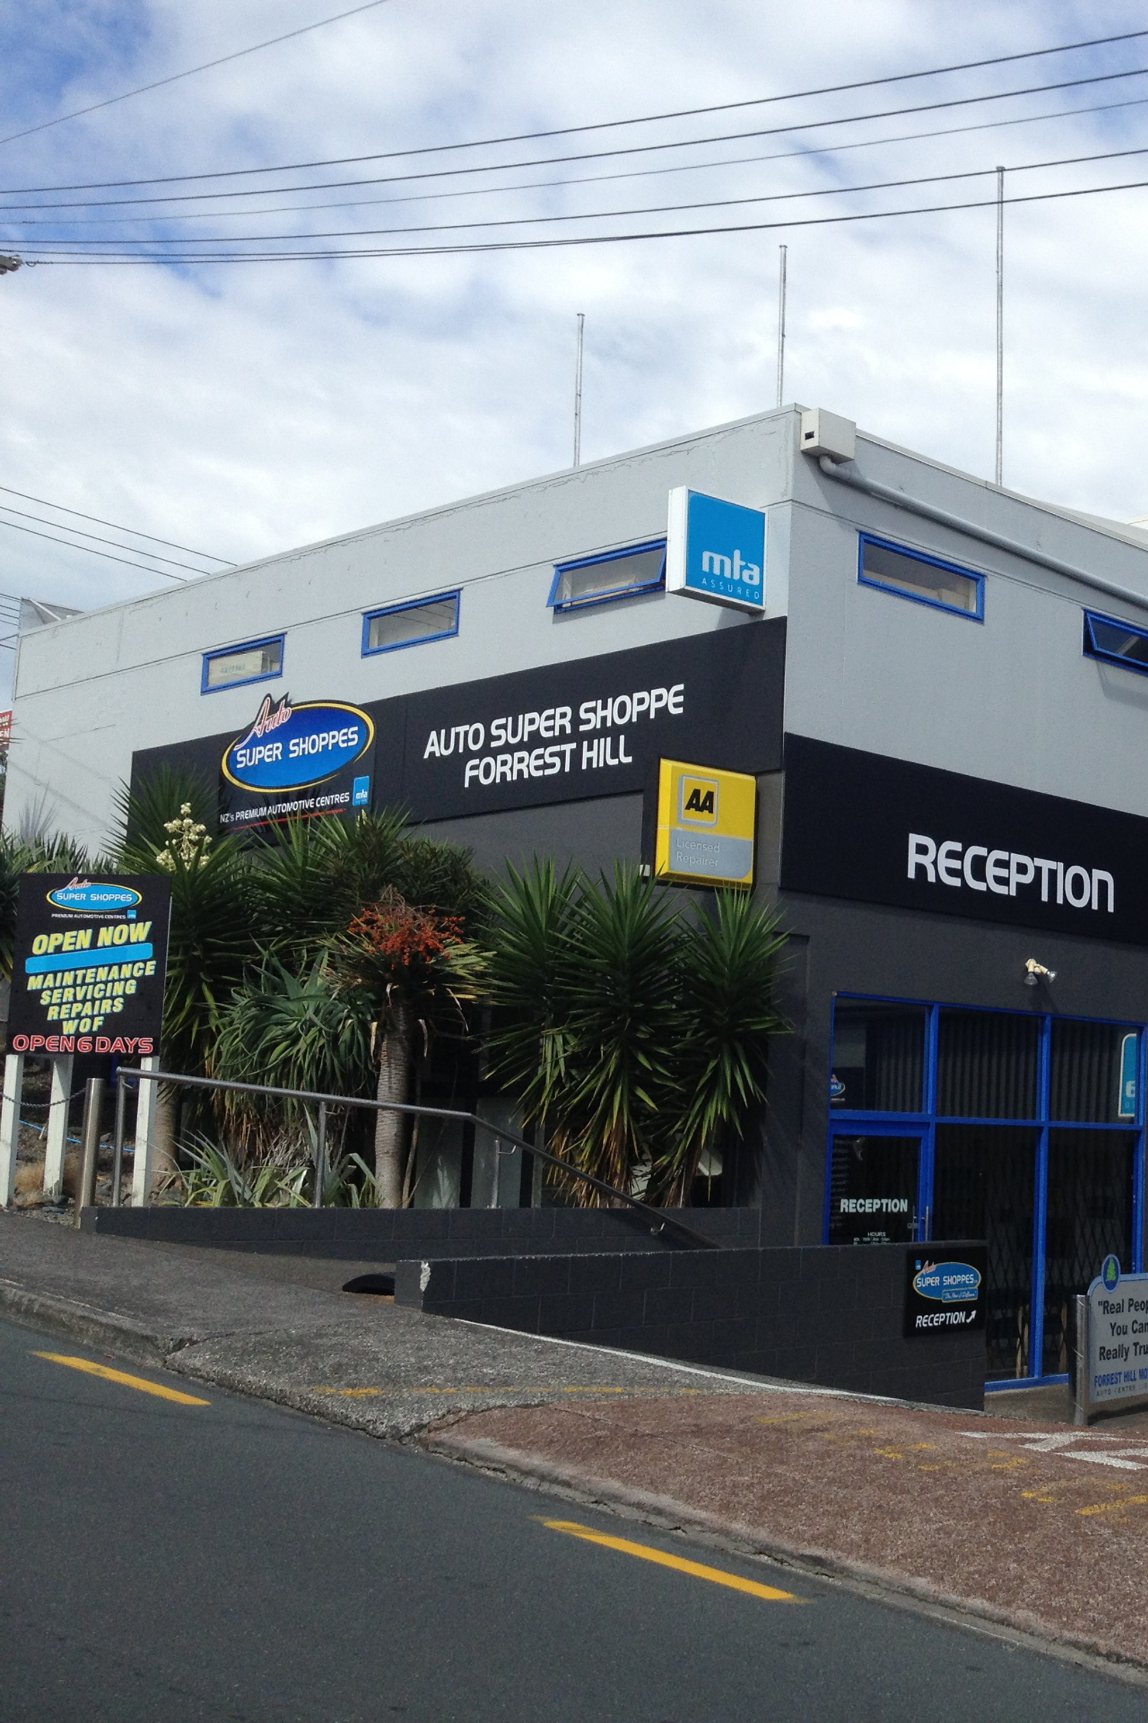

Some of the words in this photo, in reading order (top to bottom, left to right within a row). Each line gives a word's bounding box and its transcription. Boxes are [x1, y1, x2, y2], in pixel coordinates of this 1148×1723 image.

[702, 549, 760, 586] mta
[701, 578, 760, 600] ASSURED
[234, 697, 292, 750] Auto
[423, 722, 484, 759] AUTO
[490, 705, 572, 747] SUPER
[578, 683, 685, 732] SHOPPE
[236, 742, 282, 768] SUPER
[288, 726, 359, 758] SHOPPES
[464, 742, 577, 788] FORREST
[581, 735, 633, 770] HILL
[235, 806, 267, 821] PREMIUM
[267, 798, 315, 815] AUTOMOTIVE
[315, 791, 350, 807] CENTRES
[684, 788, 715, 814] AA
[676, 839, 720, 853] Licensed
[676, 851, 719, 867] Repairer
[907, 832, 1114, 913] RECEPTION
[56, 893, 86, 901] SUPER
[90, 893, 133, 902] SHOPPES
[32, 928, 93, 955] OPEN
[97, 921, 153, 947] NOW
[26, 960, 157, 991] MAINTENANCE
[39, 979, 137, 1005] SERVICING
[47, 997, 124, 1021] REPAIRS
[62, 1016, 105, 1035] WOF
[12, 1034, 75, 1053] OPEN
[77, 1036, 93, 1053] 6
[95, 1036, 154, 1054] DAYS
[840, 1198, 908, 1213] RECEPTION
[916, 1276, 940, 1288] SUPER
[942, 1274, 974, 1286] SHOPPES
[915, 1311, 966, 1328] RECEPTION
[1109, 1321, 1128, 1337] You
[1099, 1343, 1130, 1363] Really
[1094, 1371, 1122, 1388] FORREST
[1123, 1369, 1136, 1383] HILL
